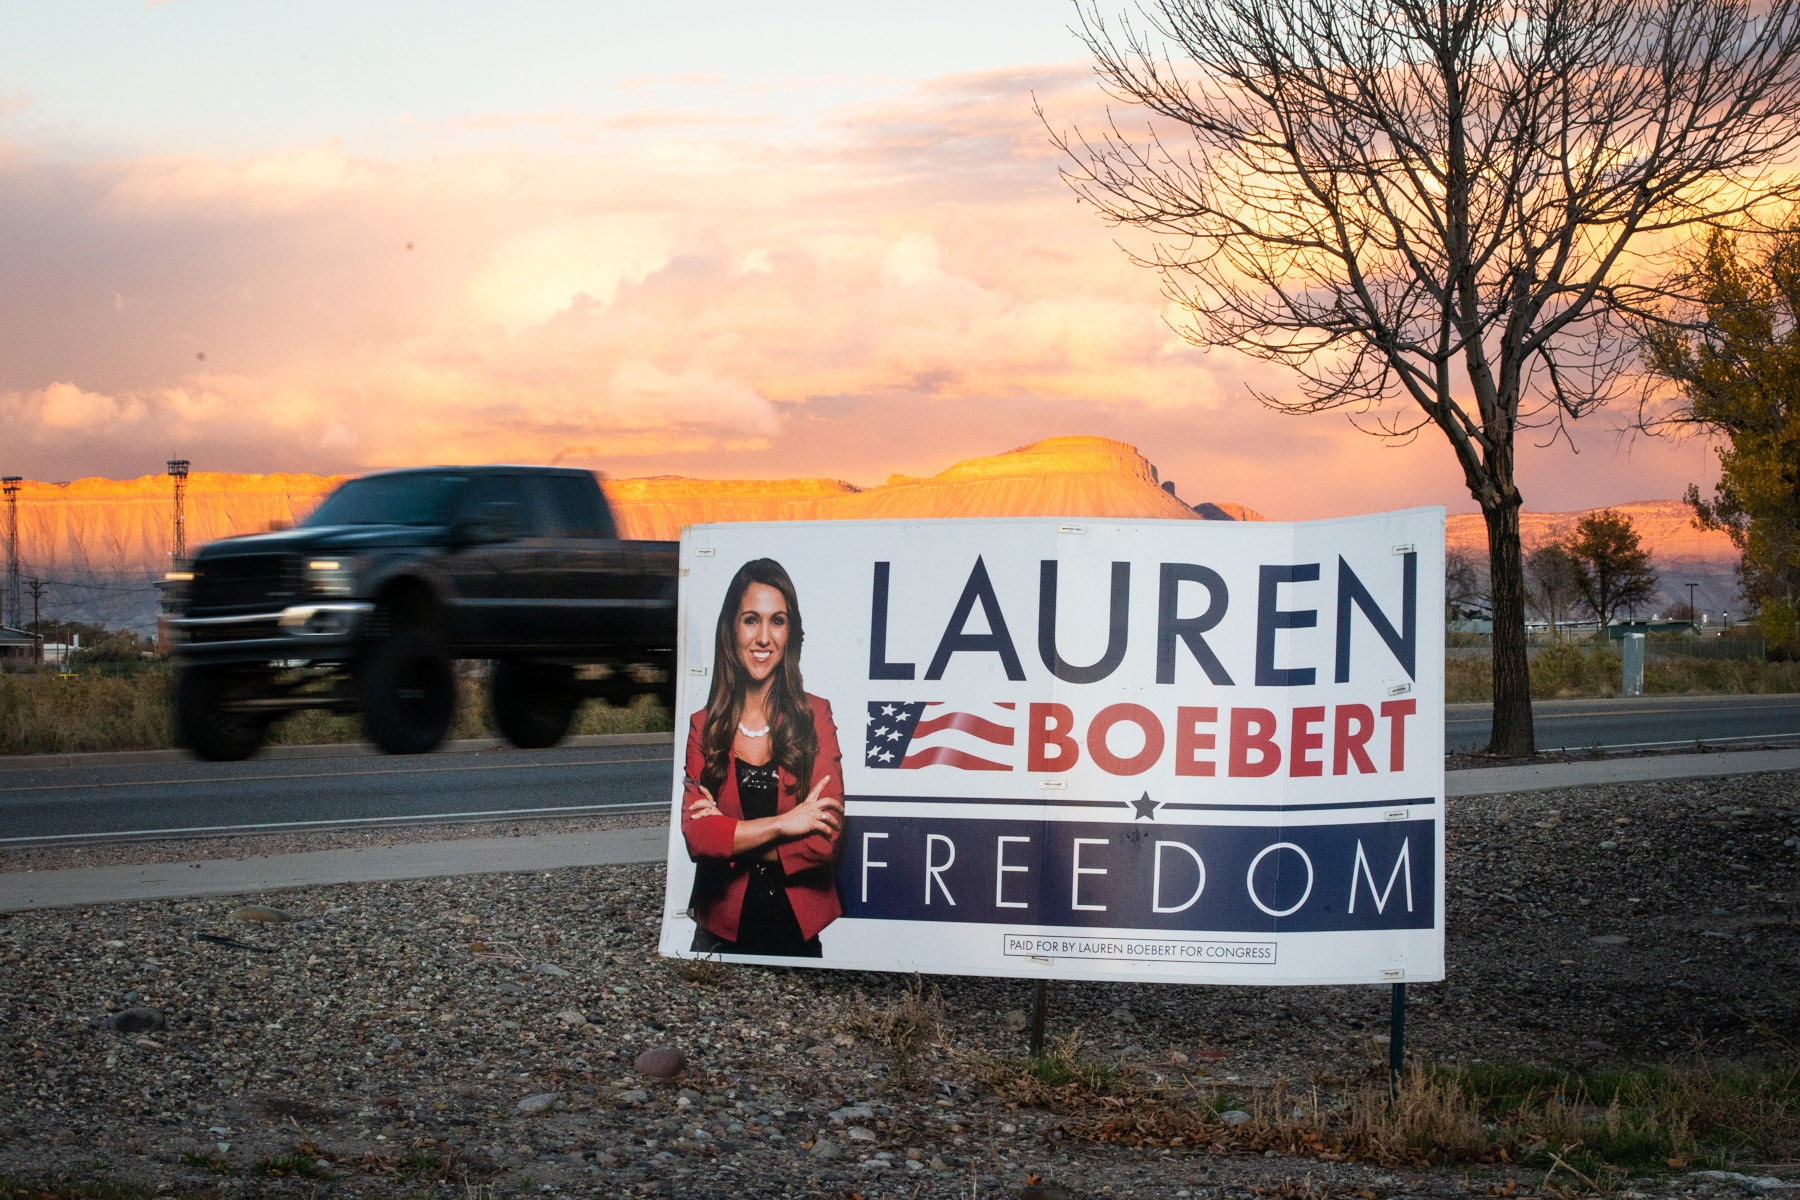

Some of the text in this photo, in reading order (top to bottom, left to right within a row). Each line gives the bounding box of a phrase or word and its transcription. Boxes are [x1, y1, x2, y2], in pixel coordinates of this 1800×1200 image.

[868, 553, 1417, 686] LAUREN
[1027, 698, 1417, 778] BOEBERT
[861, 832, 1414, 917] FREEDOM
[1010, 939, 1271, 959] PAID FOR BY LAUREN BOEBERT FOR CONGRESS
